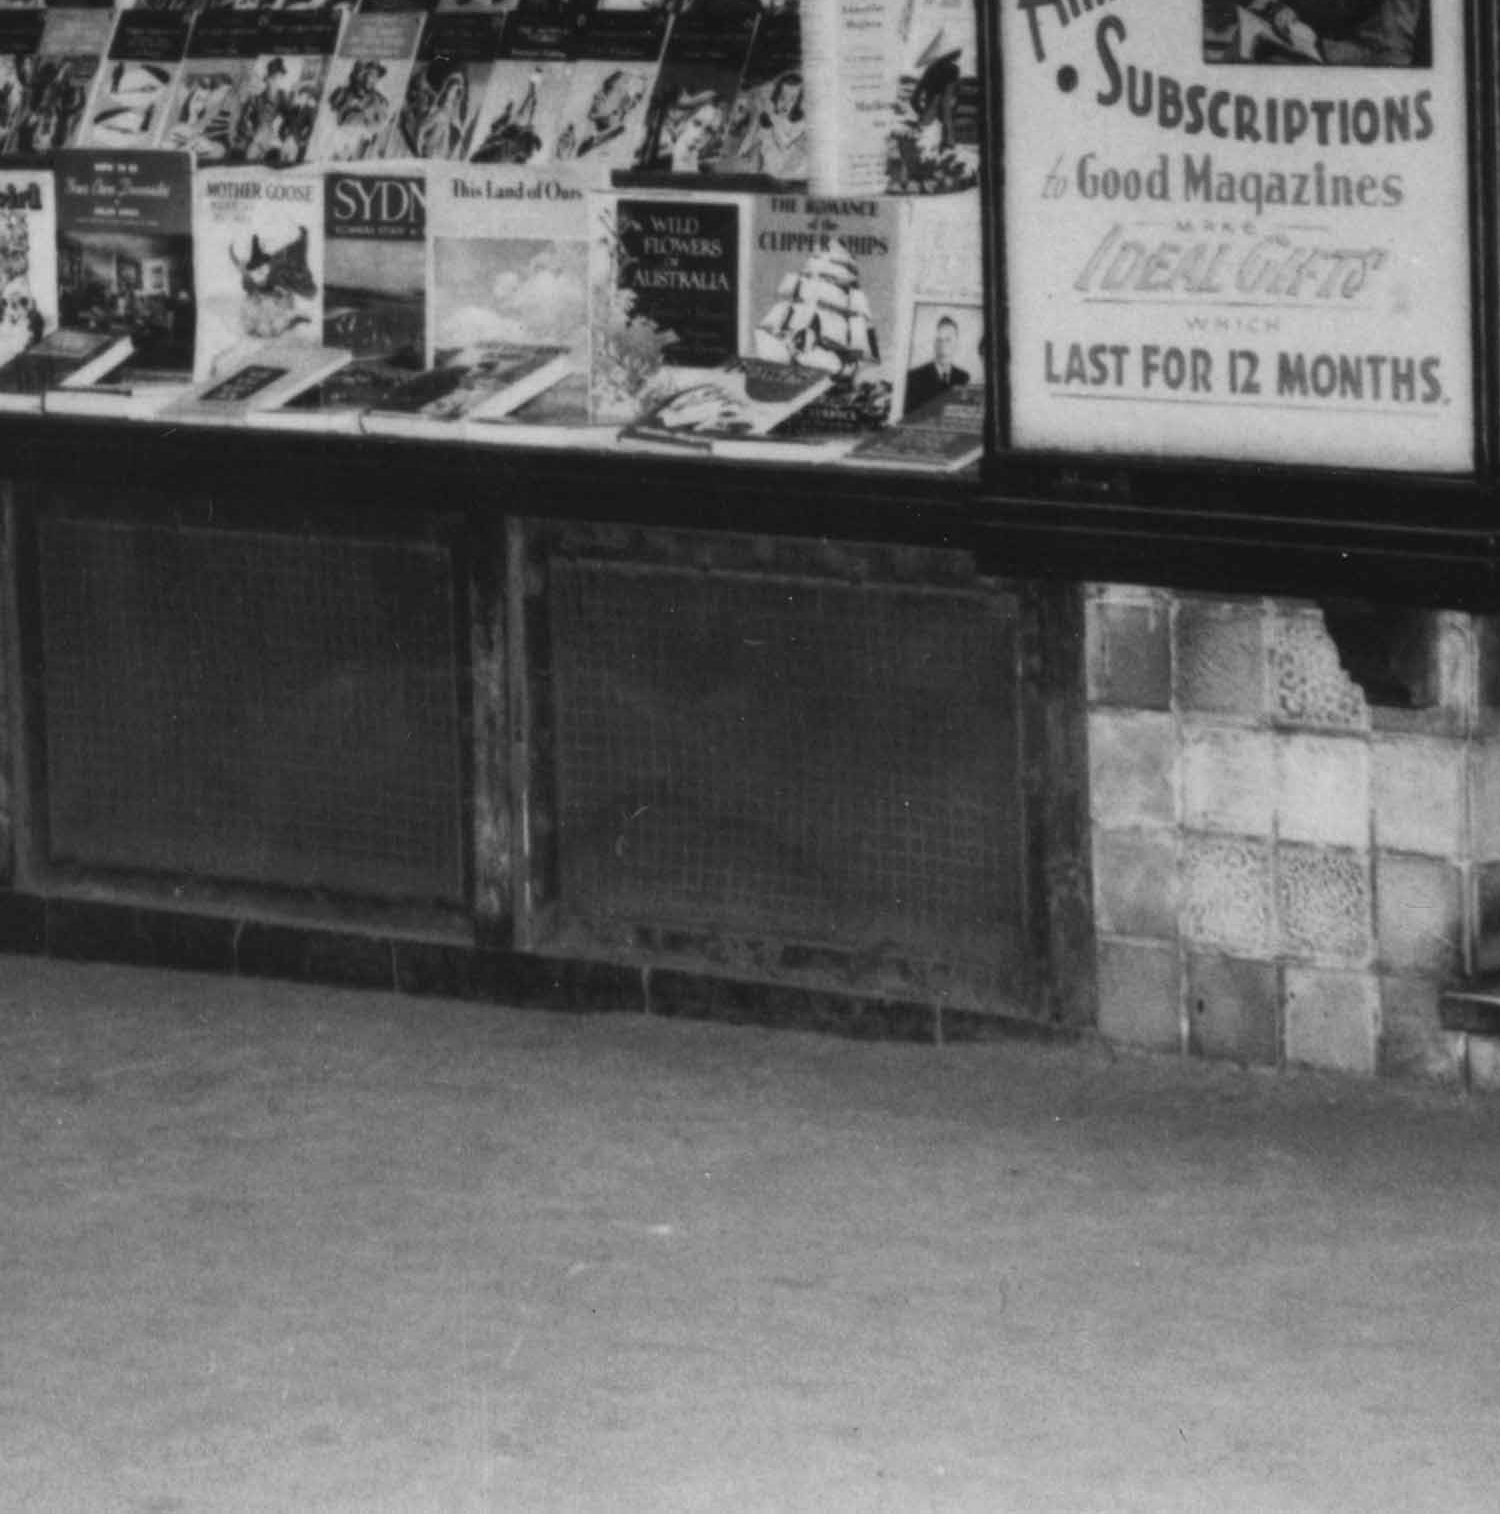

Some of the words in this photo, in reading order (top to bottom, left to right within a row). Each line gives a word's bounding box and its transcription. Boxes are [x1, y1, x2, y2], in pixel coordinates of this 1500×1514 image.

[1096, 14, 1434, 147] SUBSCRIPTIONS
[207, 180, 262, 200] MOTHER
[265, 184, 314, 203] GOOSE
[451, 177, 482, 200] This
[486, 179, 524, 200] Land
[527, 180, 542, 200] of
[545, 180, 584, 200] Ours
[1042, 153, 1068, 199] to
[1076, 152, 1170, 202] Good
[1183, 153, 1404, 215] Magazines
[771, 195, 798, 214] THE
[804, 198, 879, 218] ROMANCE
[650, 215, 700, 236] WILD
[1176, 219, 1258, 236] MAKE
[642, 237, 724, 259] FLOWERS
[758, 231, 831, 253] CLIPPER
[633, 268, 730, 292] AUSTRALIA
[1187, 315, 1281, 334] WHICH
[1044, 341, 1132, 387] LAST
[1142, 346, 1213, 394] FOR
[1229, 350, 1263, 395] 12
[1276, 352, 1451, 407] MONTHS.
